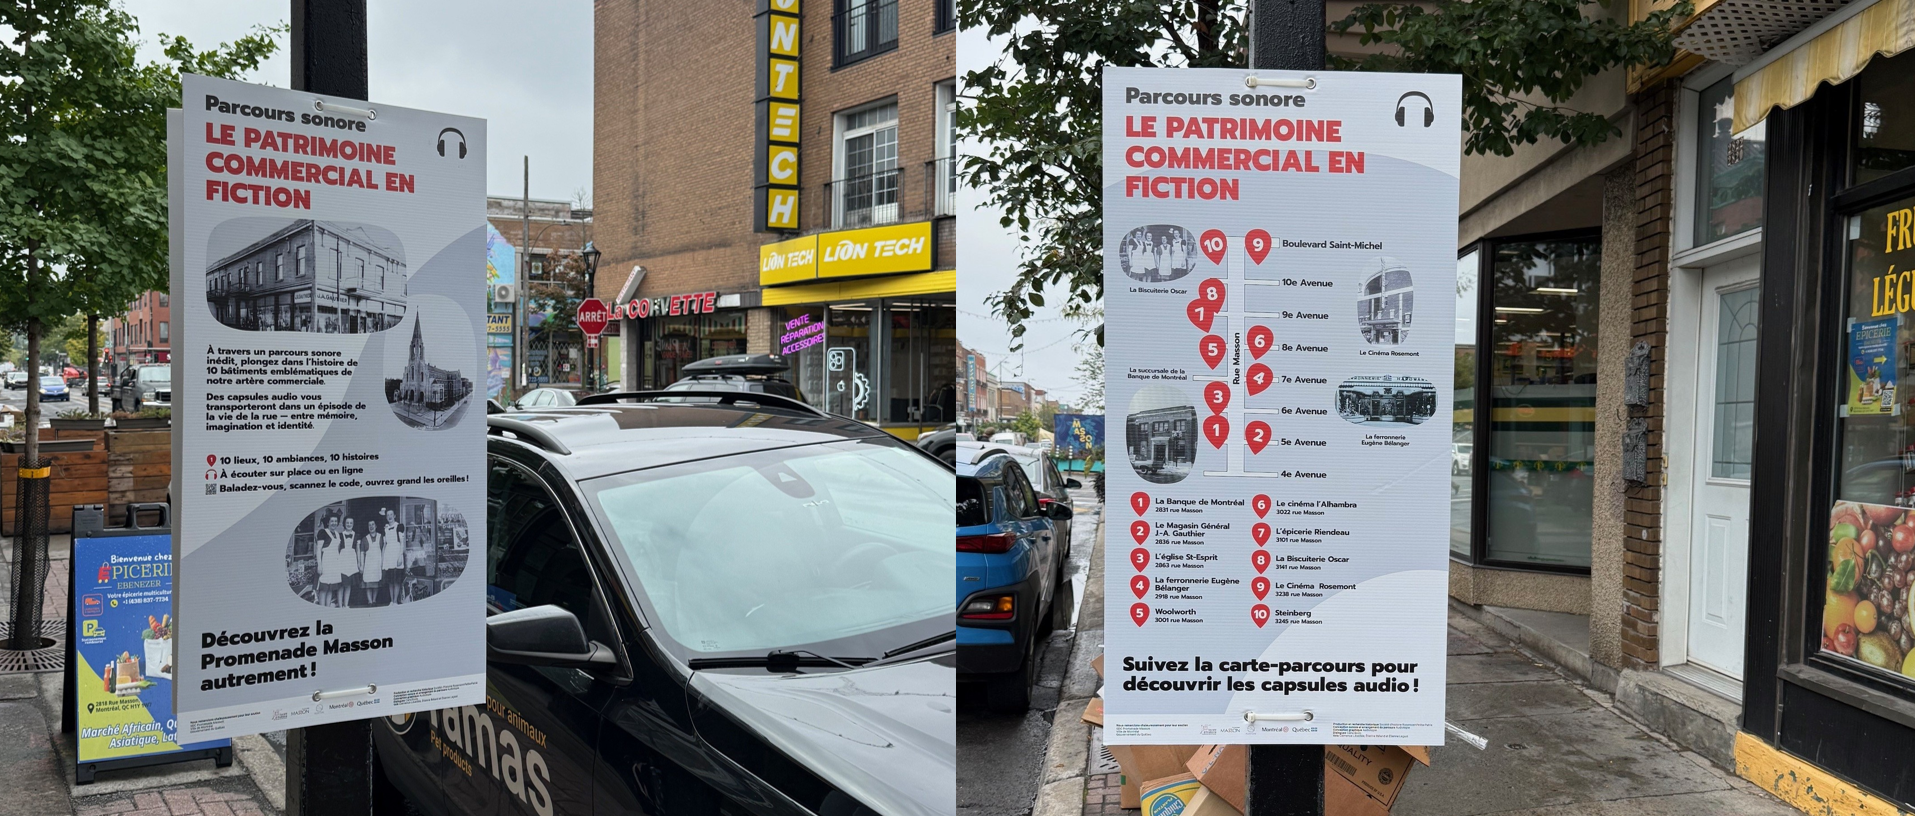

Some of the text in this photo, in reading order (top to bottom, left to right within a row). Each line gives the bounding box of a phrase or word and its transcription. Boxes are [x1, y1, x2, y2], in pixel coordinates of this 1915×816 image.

[1126, 87, 1306, 107] Parcours sonore
[206, 94, 366, 132] Parcours sonore
[1126, 116, 1341, 142] LE PATRIMOINE
[206, 122, 396, 165] LE PATRIMOINE
[1125, 146, 1364, 174] COMMERCIAL EN
[205, 152, 414, 193] COMMERCIAL EN
[206, 180, 311, 210] FICTION
[1126, 176, 1239, 200] FICTION
[1885, 206, 1915, 254] FR
[874, 236, 925, 256] TECH
[1204, 237, 1263, 253] 10 9
[1282, 240, 1382, 250] Boulevard Saint-Michel
[788, 248, 814, 266] TECH
[1300, 279, 1333, 287] Avenue
[1207, 287, 1217, 300] 8
[580, 310, 606, 322] ARRÊT
[607, 303, 623, 320] La
[1195, 308, 1205, 321] 7
[1296, 311, 1329, 320] Avenue
[785, 314, 809, 329] VENTE
[780, 321, 824, 344] RÉPARATION
[782, 333, 824, 355] ACCESSOIRES
[1254, 335, 1265, 347] 6
[1296, 344, 1328, 352] Avenue
[207, 344, 214, 358] À
[218, 347, 251, 358] travers
[1208, 344, 1218, 356] 5
[207, 356, 358, 368] inédit, plongez dans l'histoire de
[206, 366, 218, 374] 10
[220, 366, 268, 375] bâtiments
[270, 367, 338, 378] emblématiques
[1254, 372, 1264, 384] 4
[267, 376, 324, 385] commerciale.
[1213, 390, 1223, 402] 3
[1295, 407, 1328, 415] Avenue
[1212, 424, 1220, 436] 1
[1253, 429, 1263, 442] 2
[220, 456, 231, 465] 10
[234, 456, 260, 465] lieux,
[276, 454, 327, 463] ambiances,
[342, 452, 379, 461] histoires
[220, 483, 286, 492] Baladez-vous,
[328, 480, 336, 488] le
[339, 479, 363, 488] code,
[397, 476, 421, 487] grand
[1166, 498, 1196, 506] Banque
[1276, 528, 1312, 536] L'épicerie
[111, 554, 152, 563] Bienvenue
[1155, 553, 1218, 562] L'église St-Esprit
[117, 580, 161, 589] EBENEZER
[1275, 610, 1311, 618] Steinberg
[202, 620, 333, 648] Découvrez la
[201, 637, 393, 670] Promenade Masson
[1123, 656, 1418, 676] Suivez la carte-parcours pour
[1123, 676, 1221, 691] découvrir
[1227, 676, 1255, 691] les
[1261, 676, 1347, 695] capsules
[357, 699, 374, 707] Québec
[486, 695, 547, 749] pour animaux
[82, 725, 120, 738] Marché
[122, 721, 163, 736] Africain,
[109, 735, 159, 749] Asiatique,
[430, 729, 472, 777] Pet products
